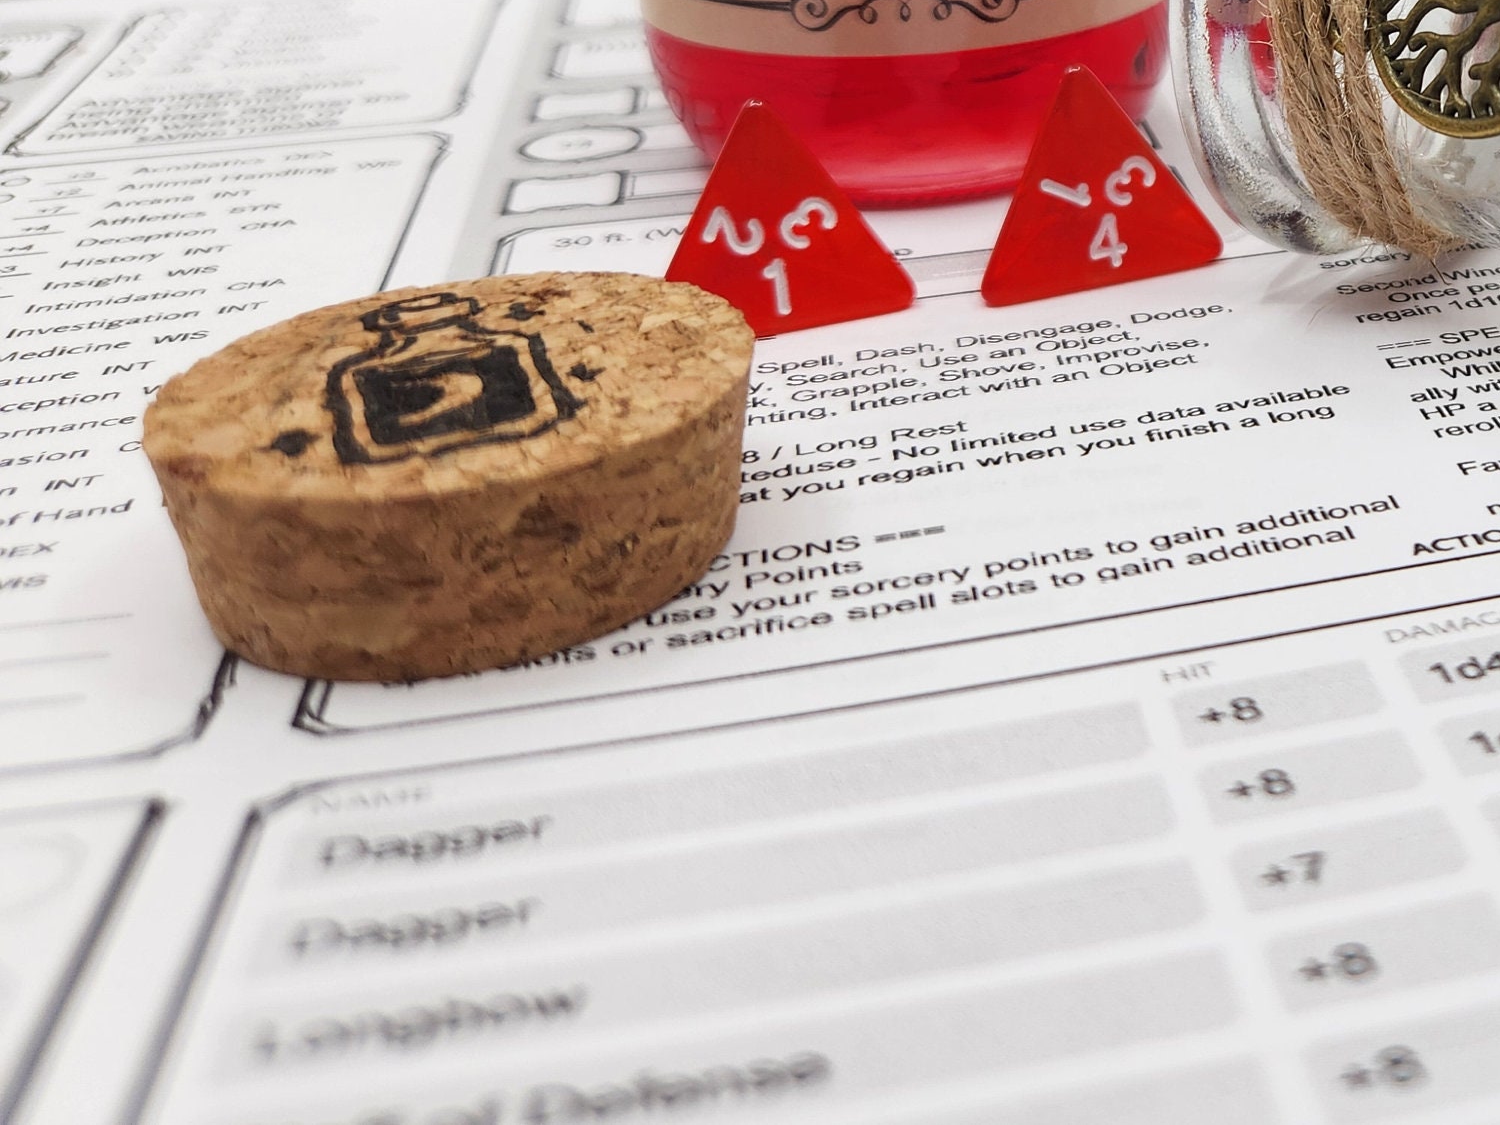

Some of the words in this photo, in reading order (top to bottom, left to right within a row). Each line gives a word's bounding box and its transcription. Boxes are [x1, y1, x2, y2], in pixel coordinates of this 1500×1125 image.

[1040, 178, 1091, 208] 1
[1106, 155, 1157, 208] 3
[89, 211, 207, 227] Athletics
[702, 206, 765, 256] 2
[779, 197, 839, 250] 3
[75, 228, 218, 247] Deception
[553, 236, 593, 249] 30
[1089, 213, 1127, 268] 4
[43, 274, 142, 290] Insight
[167, 265, 220, 277] WIS
[59, 251, 166, 268] History
[24, 288, 208, 314] Intimidation
[226, 278, 287, 292] CHA
[761, 258, 793, 316] 1
[1336, 275, 1437, 296] Second
[1389, 285, 1458, 303] Once
[5, 310, 202, 339] Investigation
[216, 301, 269, 314] INT
[1355, 300, 1441, 324] regain
[152, 330, 210, 345] WIS
[756, 355, 843, 374] Spell,
[856, 342, 945, 362] Dash,
[956, 318, 1122, 348] Disengage,
[1130, 303, 1233, 326] Dodge,
[0, 369, 80, 388] ature
[101, 360, 156, 375] INT
[786, 362, 907, 387] Search,
[919, 353, 979, 369] Use
[989, 346, 1026, 359] an
[1035, 330, 1140, 352] Object,
[791, 377, 927, 403] Grapple,
[939, 360, 1046, 382] Shove,
[1056, 336, 1210, 366] Improvise,
[850, 386, 971, 412] Interact
[979, 377, 1041, 394] with
[1052, 370, 1090, 384] an
[1099, 353, 1199, 376] Object
[1410, 387, 1459, 403] ally
[0, 390, 121, 413] ception
[1419, 403, 1466, 421] HP
[796, 435, 878, 456] Long
[891, 420, 968, 442] Rest
[892, 445, 940, 461] No
[950, 425, 1057, 452] limited
[1070, 417, 1127, 434] use
[1137, 405, 1206, 425] data
[1215, 383, 1351, 413] available
[783, 478, 845, 501] you
[858, 459, 965, 487] regain
[977, 444, 1066, 468] when
[1077, 435, 1137, 456] you
[1145, 420, 1231, 443] finish
[1267, 405, 1336, 426] long
[43, 474, 104, 492] INT
[32, 499, 135, 524] Hand
[731, 590, 820, 619] your
[830, 565, 970, 599] sorcery
[984, 544, 1093, 578] points
[1105, 537, 1138, 556] to
[1149, 526, 1225, 552] gain
[1236, 495, 1401, 535] additional
[745, 559, 864, 590] Points
[666, 612, 834, 649] sacrifice
[847, 592, 936, 620] spell
[950, 577, 1038, 606] slots
[1051, 570, 1086, 589] to
[1097, 555, 1174, 583] gain
[1187, 525, 1357, 567] additional
[1161, 661, 1214, 683] HIT
[322, 815, 553, 868] Dagger
[1198, 696, 1264, 724] +8
[292, 896, 540, 957] Dagger
[1225, 768, 1296, 796] +8
[1260, 849, 1328, 891] +7
[1297, 940, 1380, 987] +8
